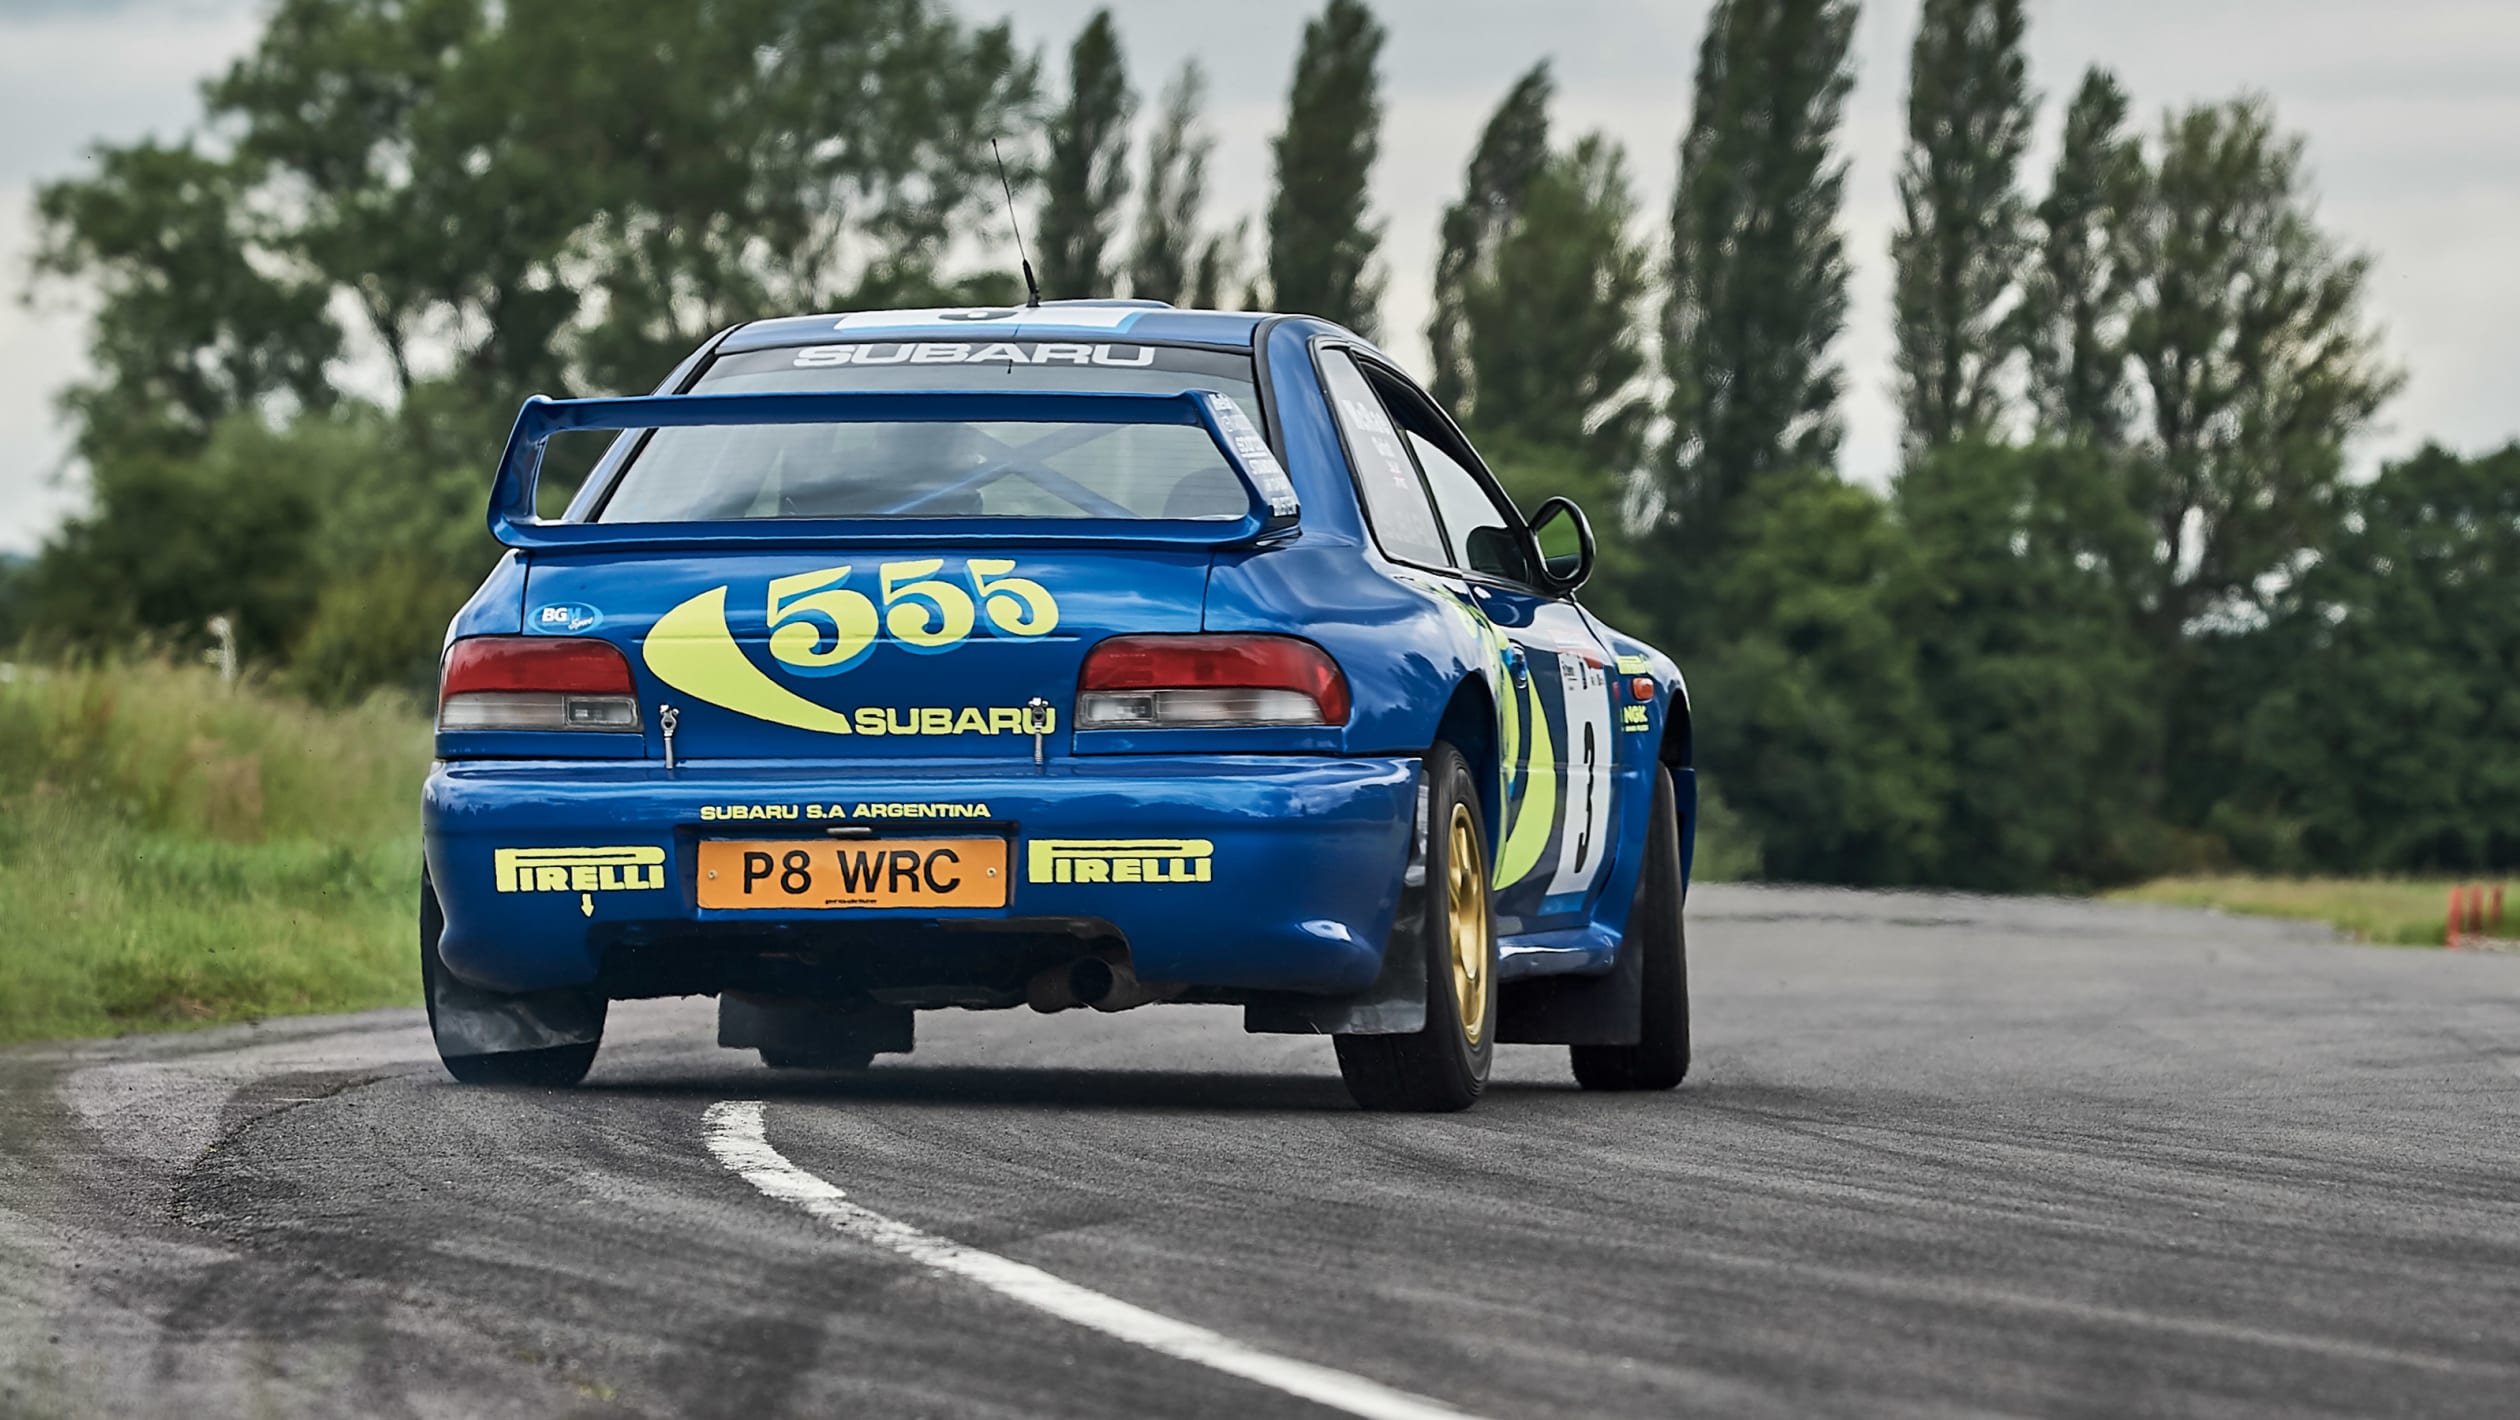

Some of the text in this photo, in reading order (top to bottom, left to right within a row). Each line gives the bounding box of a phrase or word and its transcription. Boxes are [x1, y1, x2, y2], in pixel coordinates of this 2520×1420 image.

[794, 342, 1155, 367] SUBARU
[541, 607, 582, 622] BGM
[766, 558, 1060, 674] 555
[854, 707, 1056, 735] SUBARU
[1624, 705, 1649, 724] NGK
[700, 802, 991, 820] SUBARU S.A ARGENTINA
[1574, 720, 1596, 875] 3
[495, 846, 666, 893] PIRELLI
[743, 848, 961, 894] P8 WRC
[1028, 839, 1214, 883] PIRELLI
